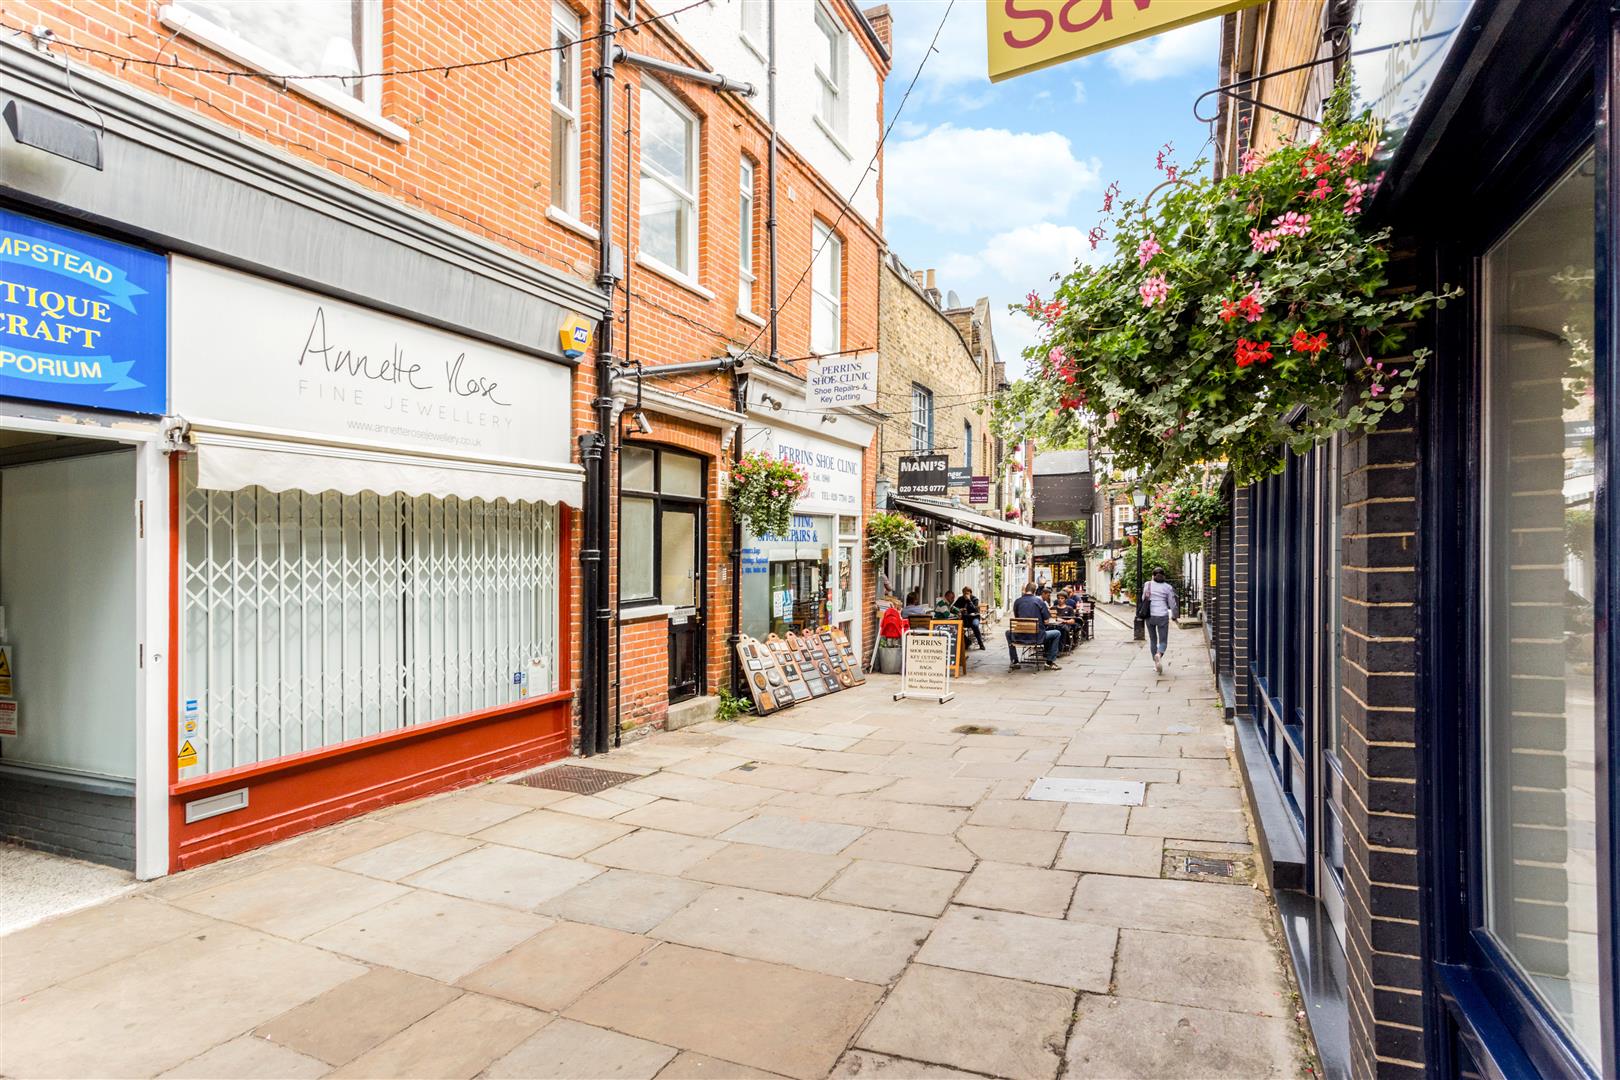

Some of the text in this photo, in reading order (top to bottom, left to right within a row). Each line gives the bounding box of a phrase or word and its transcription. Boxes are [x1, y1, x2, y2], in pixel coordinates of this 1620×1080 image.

[1003, 0, 1152, 49] sa
[0, 280, 112, 323] TIQUE
[575, 328, 587, 342] ADT
[298, 306, 512, 406] Annette Rose
[822, 362, 862, 374] PERRINS
[812, 371, 871, 386] SHOE CLINIC
[814, 387, 832, 395] Shoe
[833, 385, 860, 394] Repairs
[299, 379, 512, 430] FINE JEWELLERY
[820, 394, 861, 404] Key Cutting
[778, 444, 858, 476] PERRINS SHOE CLINIC
[900, 460, 946, 472] MANI'S
[929, 484, 946, 492] 0777
